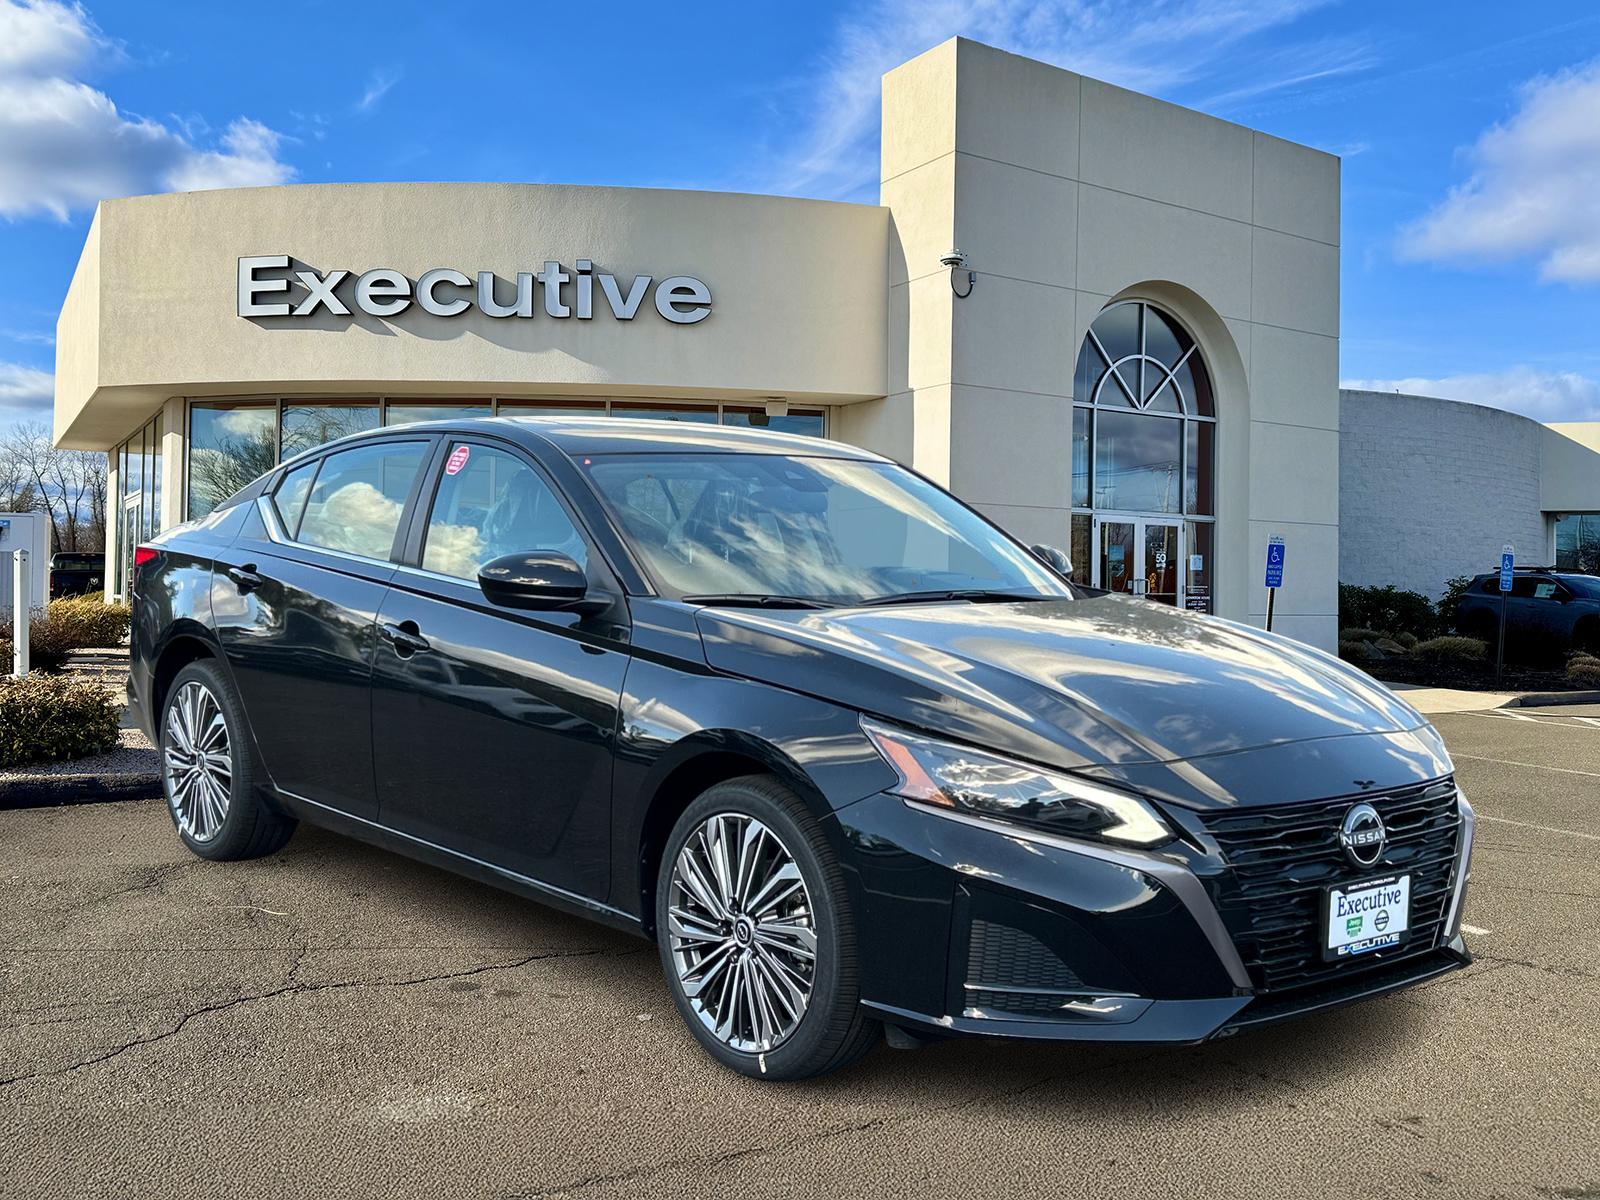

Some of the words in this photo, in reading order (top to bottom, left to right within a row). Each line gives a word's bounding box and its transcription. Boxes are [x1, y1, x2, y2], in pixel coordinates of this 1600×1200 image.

[237, 255, 712, 324] Executive
[1342, 830, 1386, 846] NISSAN
[1336, 887, 1401, 917] Executive
[1338, 933, 1400, 955] EXECUTIVE
